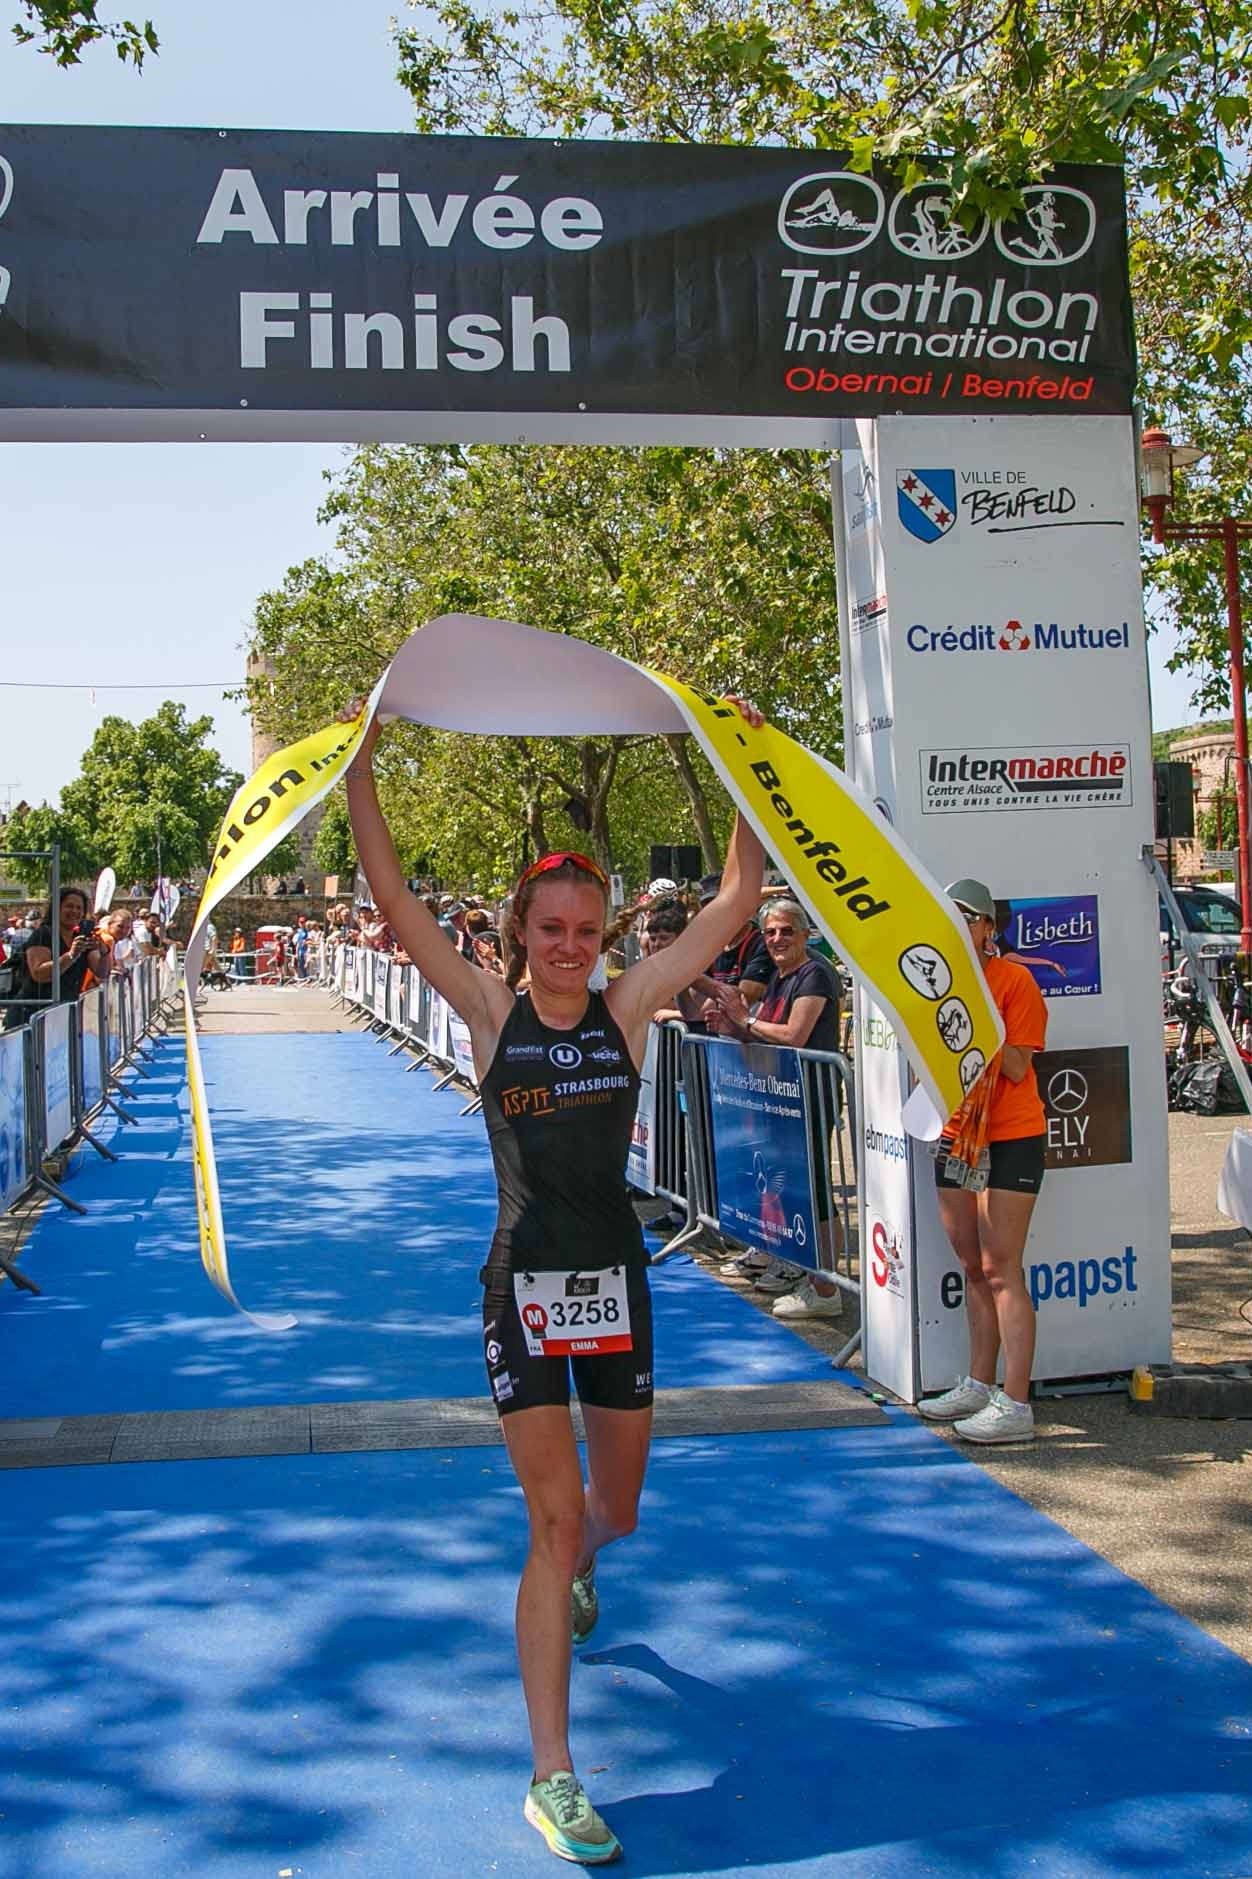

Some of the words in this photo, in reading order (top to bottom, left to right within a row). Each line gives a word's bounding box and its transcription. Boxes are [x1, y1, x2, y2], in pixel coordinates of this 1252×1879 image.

[197, 168, 604, 250] Arrivée
[781, 269, 1098, 331] Triathlon
[239, 291, 571, 372] Finish
[784, 321, 1090, 363] International
[785, 367, 933, 395] Obernai
[962, 373, 1094, 400] Benfeld
[961, 471, 1002, 484] VILLE
[1006, 471, 1027, 484] DE
[961, 488, 1076, 525] BENFELD
[907, 624, 995, 652] Crédit
[1034, 623, 1129, 650] Mutuel
[929, 751, 1127, 788] Intermarché
[927, 784, 965, 796] Centre
[967, 783, 1003, 794] Alsace
[929, 798, 957, 808] TOUS
[963, 797, 990, 806] UNIS
[996, 795, 1039, 805] CONTRE
[1045, 794, 1058, 803] LA
[1064, 793, 1081, 802] VIE
[749, 759, 890, 922] Benfeld
[1017, 911, 1092, 949] Lisbeth
[554, 1075, 630, 1095] STRASBOURG
[768, 1074, 800, 1098] Obernai
[526, 1310, 544, 1326] M
[550, 1297, 620, 1327] 3258
[570, 1341, 599, 1351] EMMA
